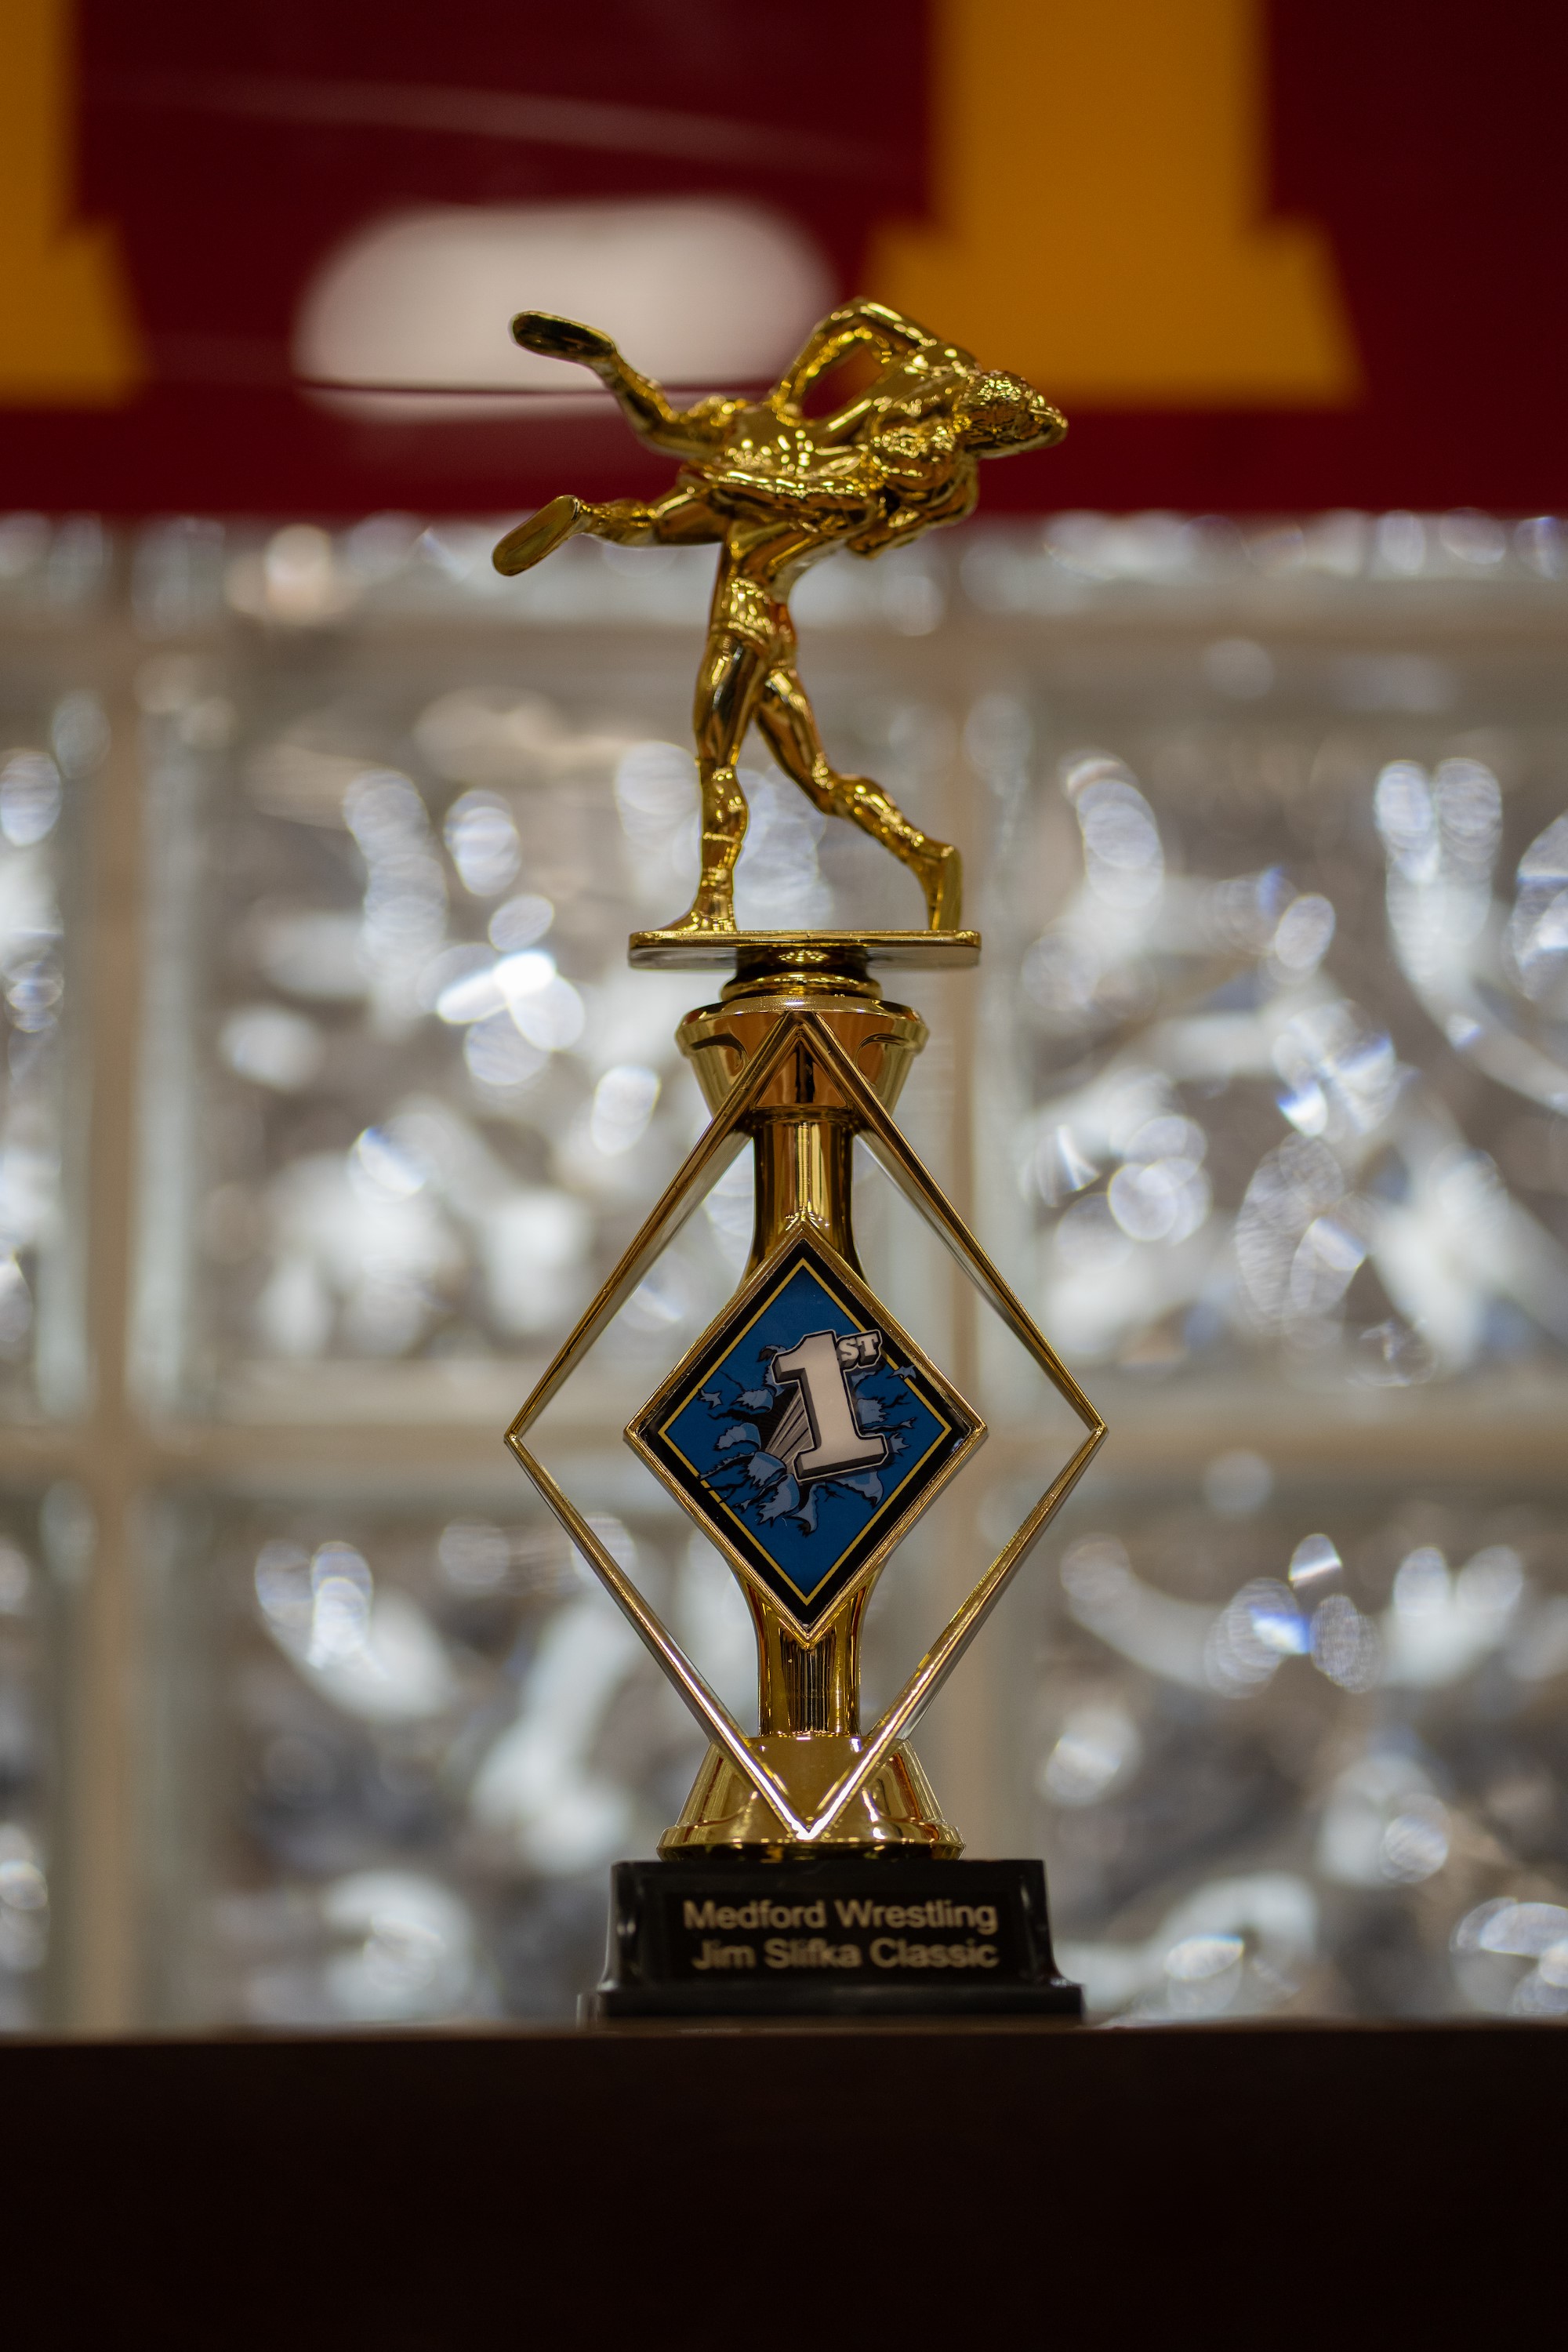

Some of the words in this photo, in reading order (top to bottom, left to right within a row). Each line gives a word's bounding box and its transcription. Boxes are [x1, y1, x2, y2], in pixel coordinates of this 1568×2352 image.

[771, 1330, 888, 1482] 1ST
[684, 1900, 827, 1929] Medford
[834, 1900, 998, 1935] Wrestling
[692, 1939, 757, 1969] Jim
[869, 1938, 999, 1968] Classic
